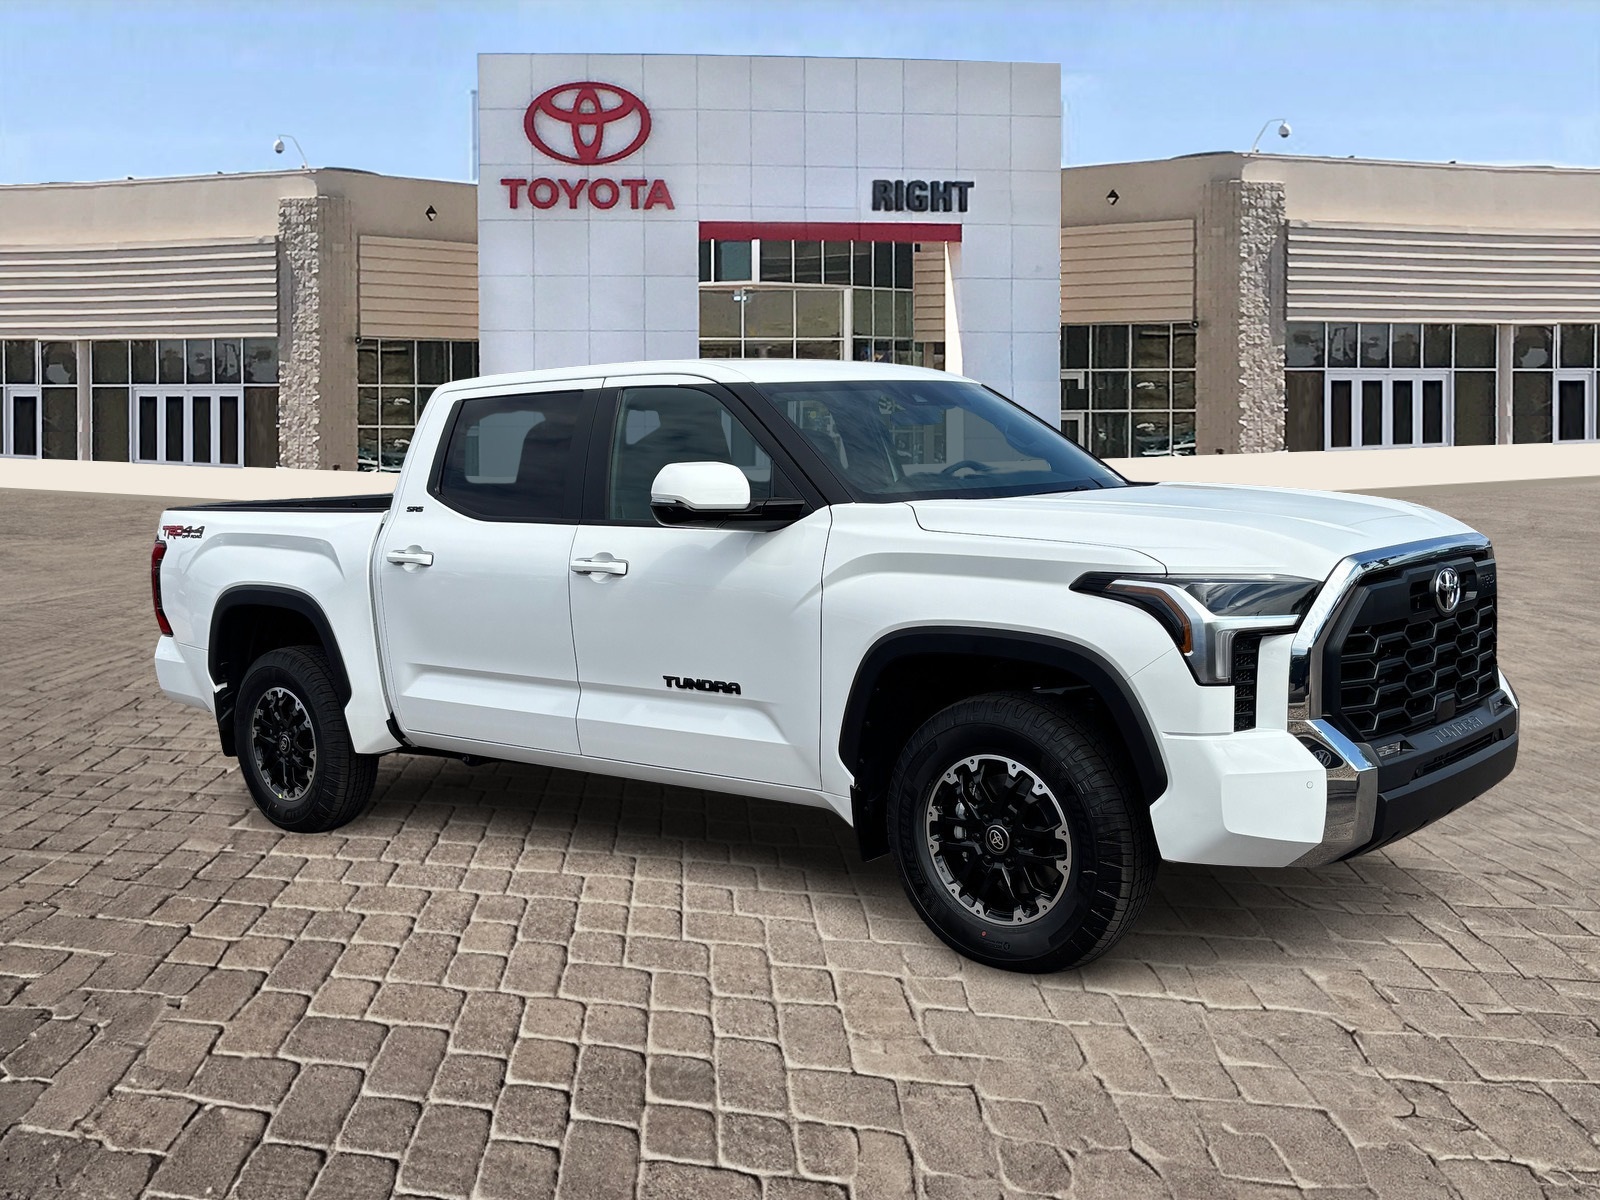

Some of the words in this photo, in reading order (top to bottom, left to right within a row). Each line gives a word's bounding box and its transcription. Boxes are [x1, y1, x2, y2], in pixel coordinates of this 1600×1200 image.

[500, 178, 675, 210] TOYOTA
[871, 179, 975, 213] RIGHT
[406, 505, 424, 513] SR5
[162, 525, 184, 539] TRD
[662, 675, 741, 695] TUNDRA
